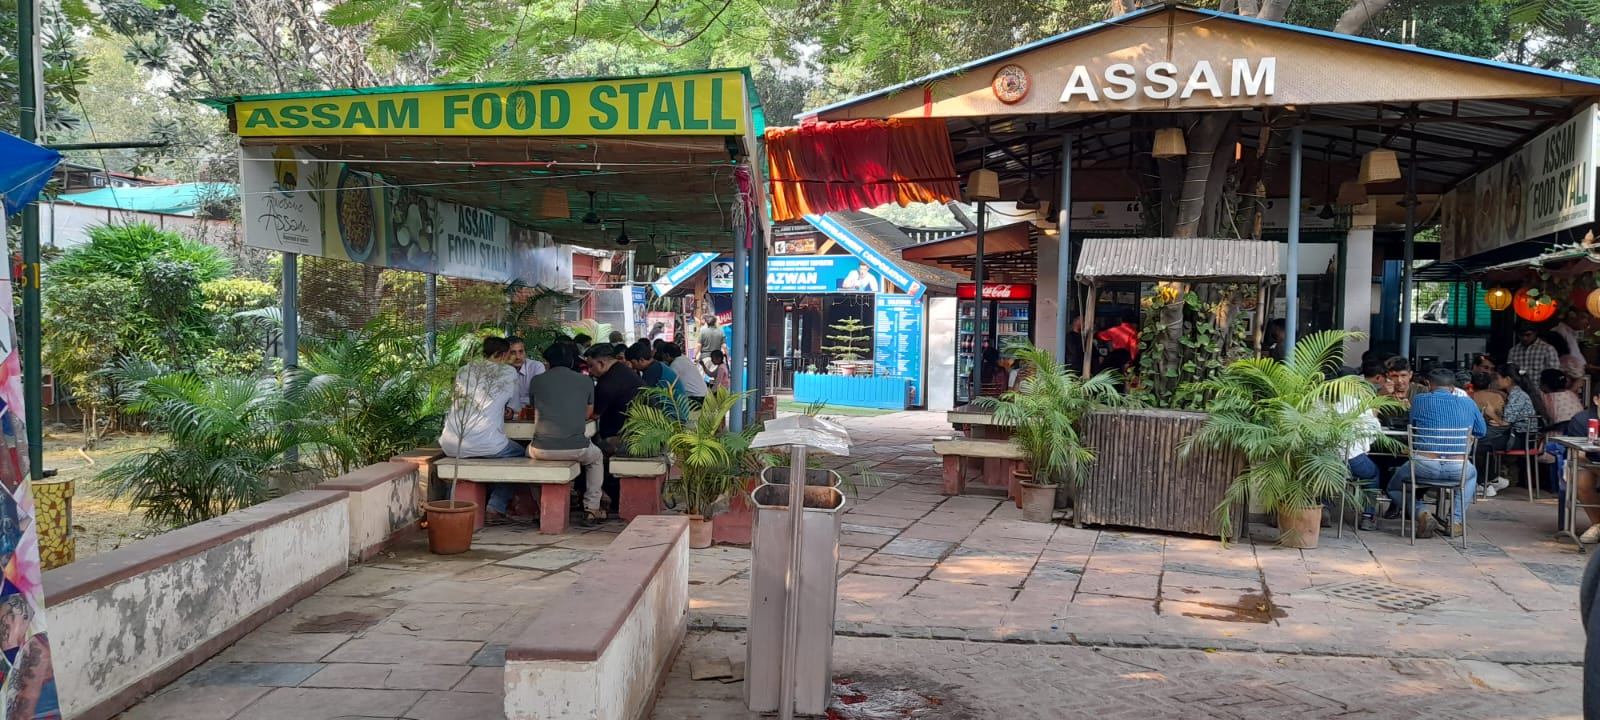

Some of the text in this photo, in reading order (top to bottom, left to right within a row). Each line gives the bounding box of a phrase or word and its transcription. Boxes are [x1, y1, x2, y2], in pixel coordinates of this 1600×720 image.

[1059, 57, 1277, 103] ASSAM
[244, 78, 737, 130] ASSAM FOOD STALL
[1543, 121, 1577, 175] ASSAM
[1533, 162, 1588, 219] FOOD STALL
[457, 205, 496, 242] ASSAM
[448, 234, 508, 271] FOOD STALL
[766, 272, 818, 285] AZWAN
